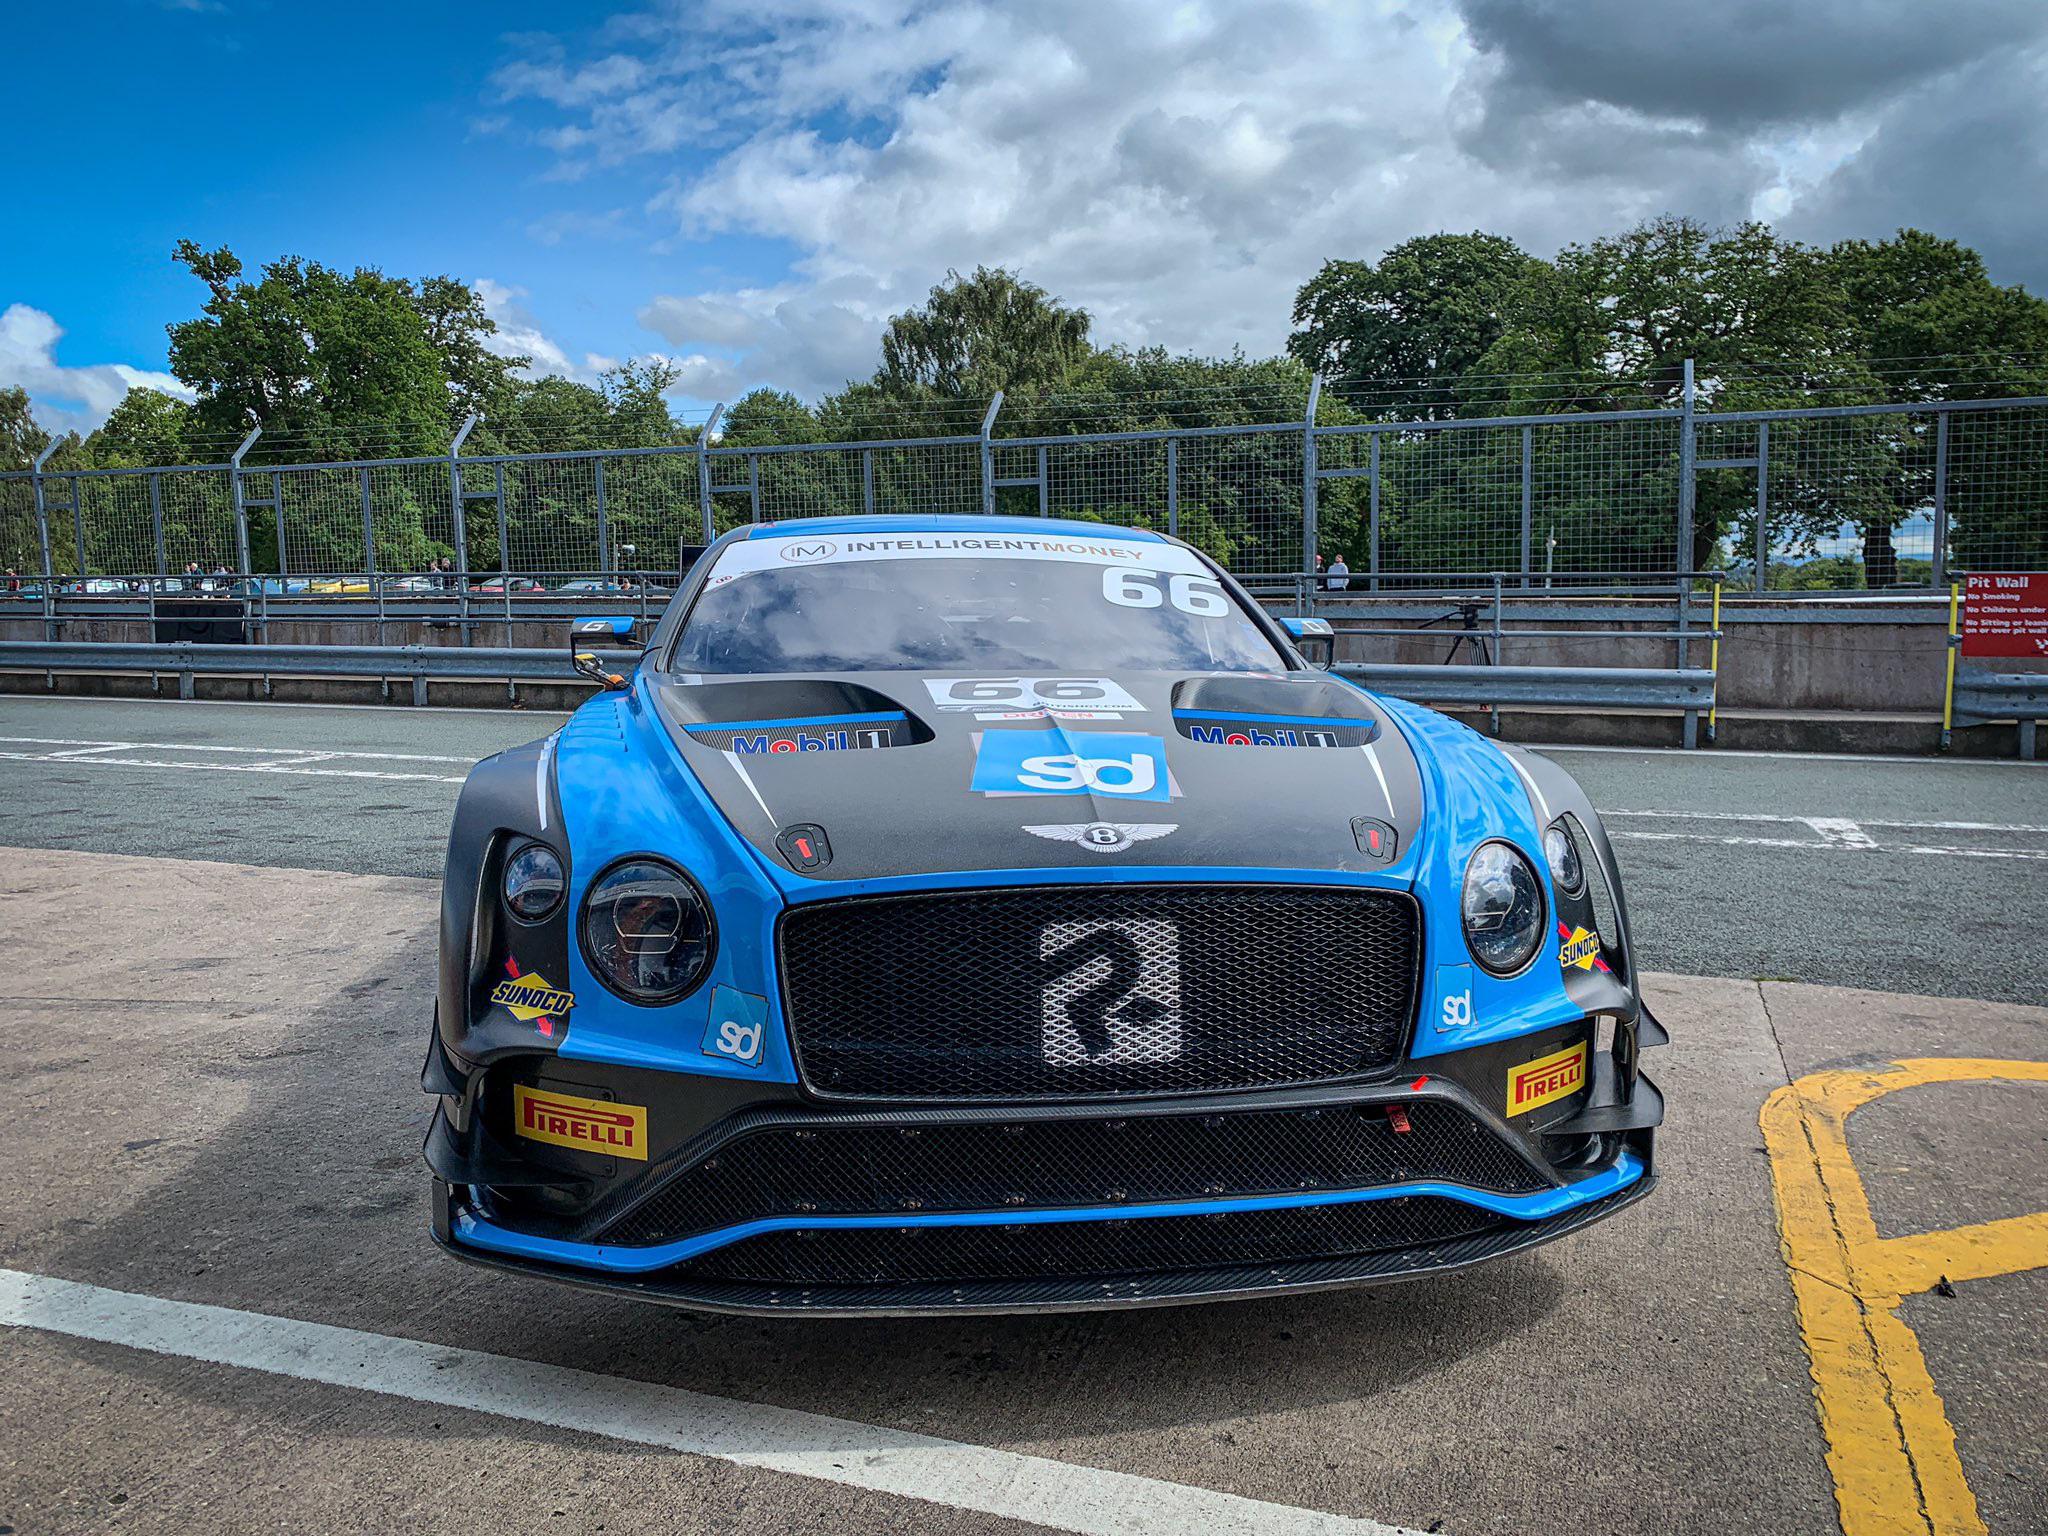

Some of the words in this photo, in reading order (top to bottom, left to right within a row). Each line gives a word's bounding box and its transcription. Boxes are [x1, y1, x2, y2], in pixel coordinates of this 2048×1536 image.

[847, 539, 1143, 561] INTELLIGENTMONEY
[1102, 566, 1229, 618] 66
[1968, 577, 1990, 588] Pit
[1996, 576, 2029, 588] Wall
[1982, 593, 2020, 601] Smoking
[1980, 619, 2010, 627] Sitting
[949, 679, 1105, 700] 66
[732, 731, 847, 754] Mobil
[1190, 726, 1298, 747] Mobil
[1017, 753, 1155, 794] sd
[1562, 932, 1599, 967] SUNOCO
[496, 982, 572, 1013] SUNOCO
[1442, 989, 1470, 1026] sd
[716, 1021, 762, 1060] sd
[1515, 1053, 1582, 1104] PIRELLI
[523, 1096, 634, 1147] PIRELLI
